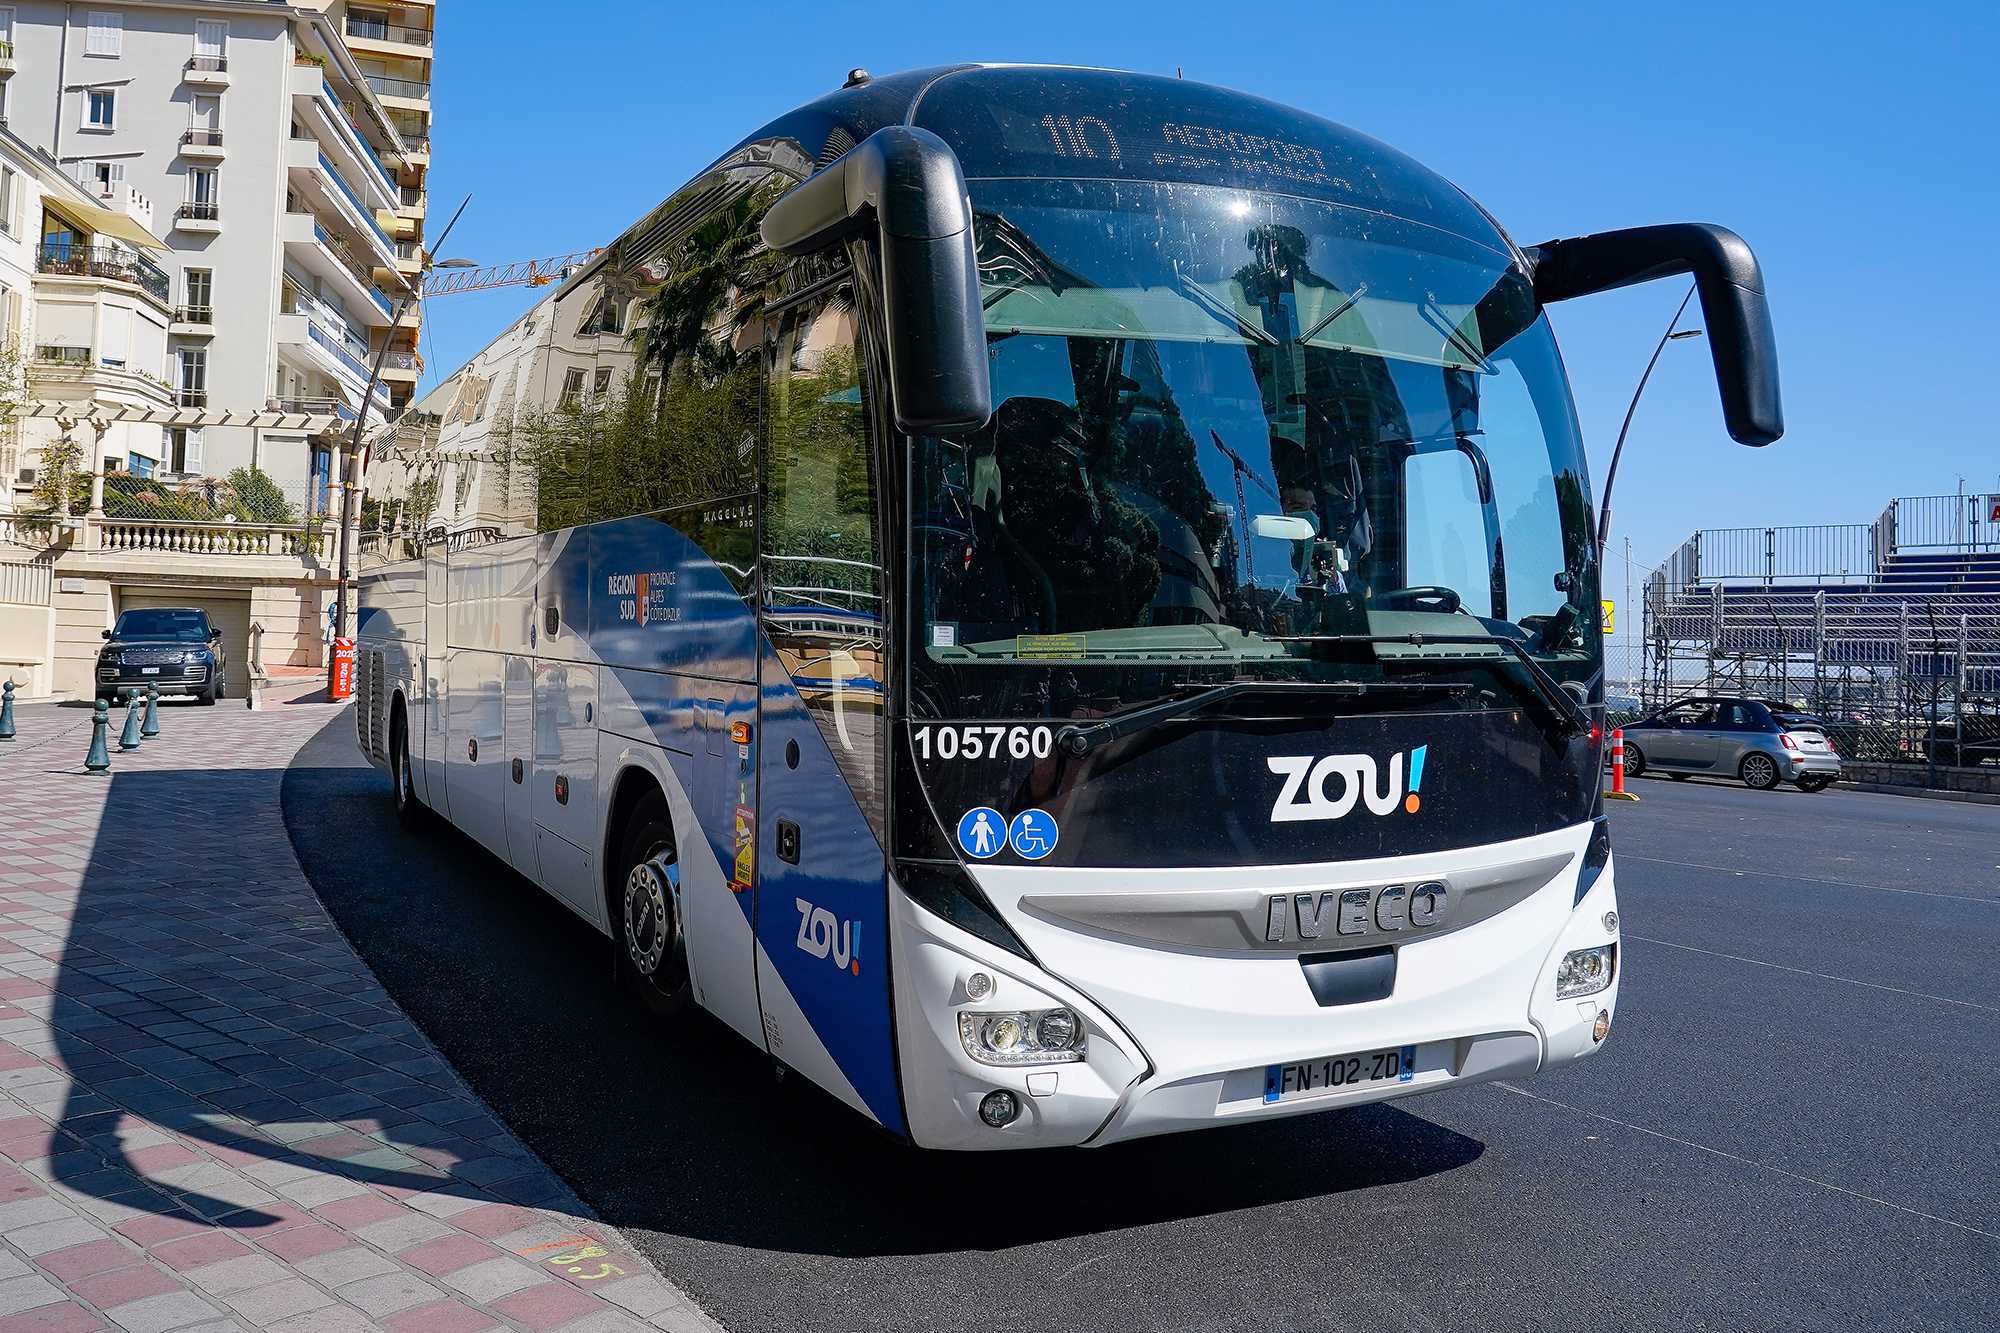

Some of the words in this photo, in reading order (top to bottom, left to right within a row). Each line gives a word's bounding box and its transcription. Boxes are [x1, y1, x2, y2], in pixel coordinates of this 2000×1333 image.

[1162, 122, 1327, 170] AEROPORT
[703, 504, 753, 523] MAGELYS
[608, 572, 636, 596] RÉGION
[650, 571, 676, 587] PROVENCE
[620, 600, 636, 620] SUD
[650, 589, 665, 604] ALPES
[914, 726, 1053, 760] 105760
[1267, 744, 1428, 823] ZOU!
[1266, 881, 1450, 942] IVECO
[795, 897, 862, 977] ZOU!
